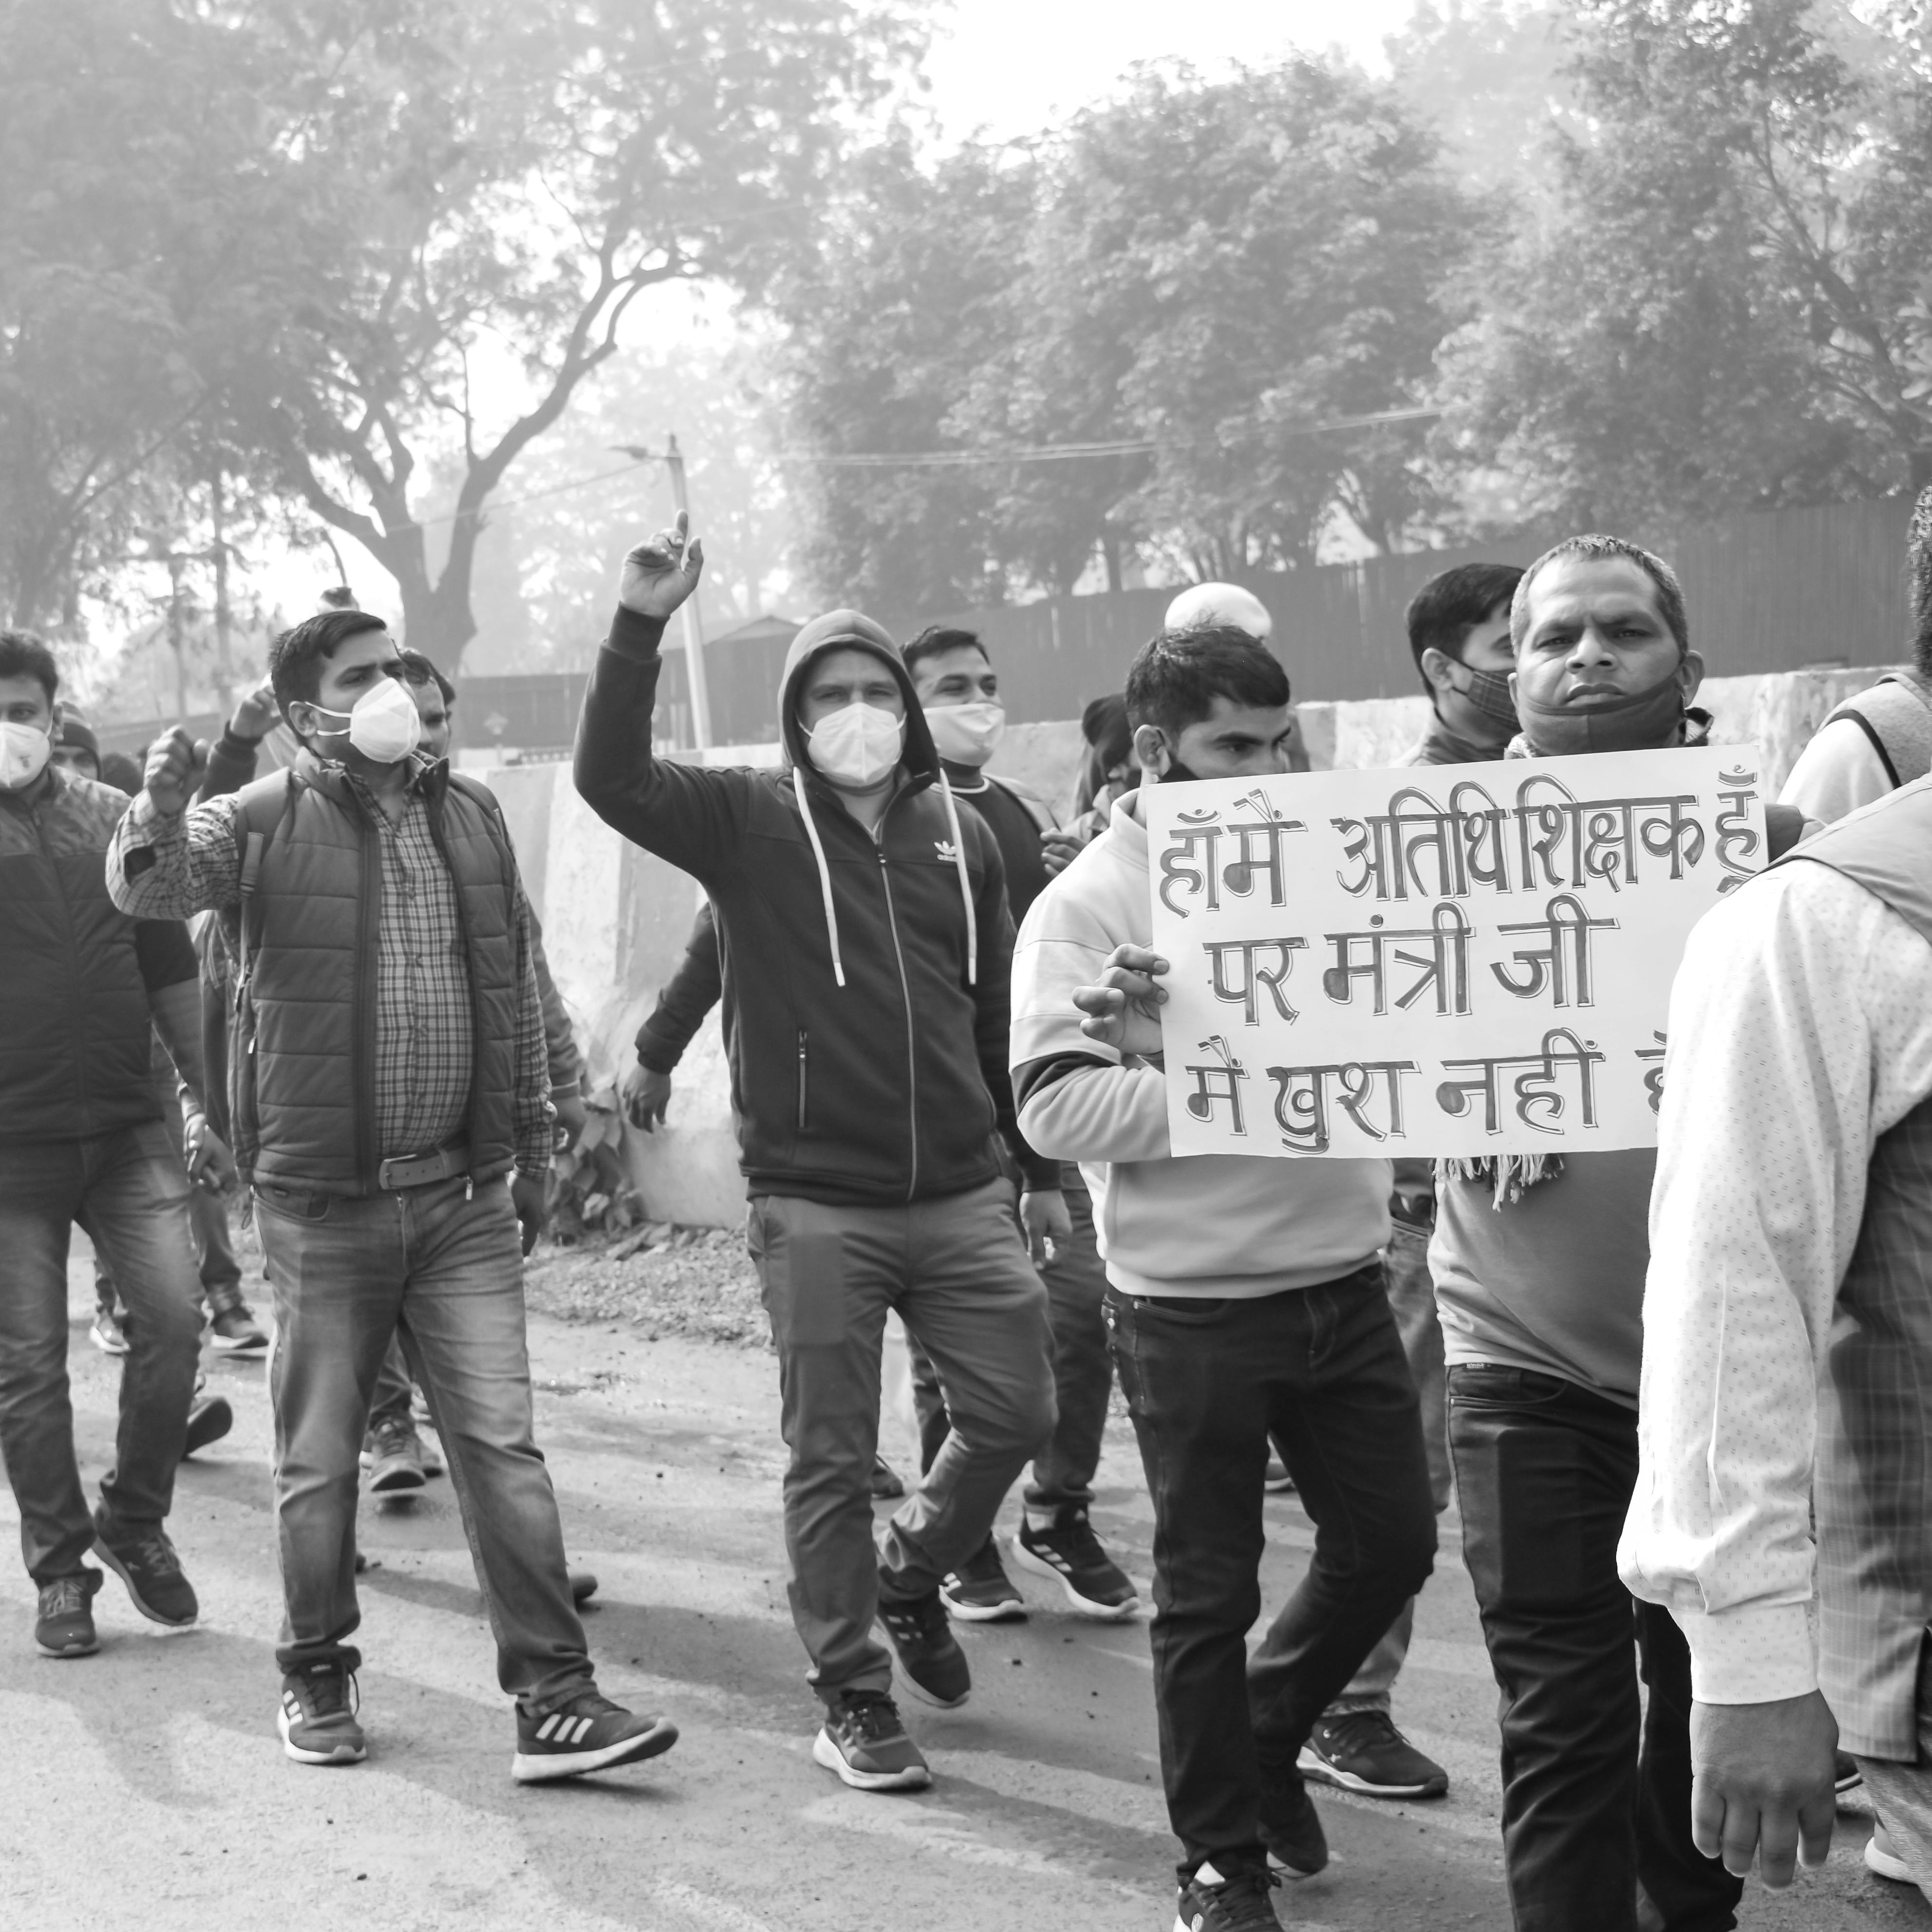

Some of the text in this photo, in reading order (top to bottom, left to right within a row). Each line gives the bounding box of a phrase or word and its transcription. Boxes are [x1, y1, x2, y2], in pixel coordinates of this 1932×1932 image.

[1202, 892, 1621, 1026] पर मंत्री जी
[1185, 1035, 1250, 1136] मैं
[1266, 1061, 1422, 1155] खुश
[1436, 1027, 1606, 1136] नहीं
